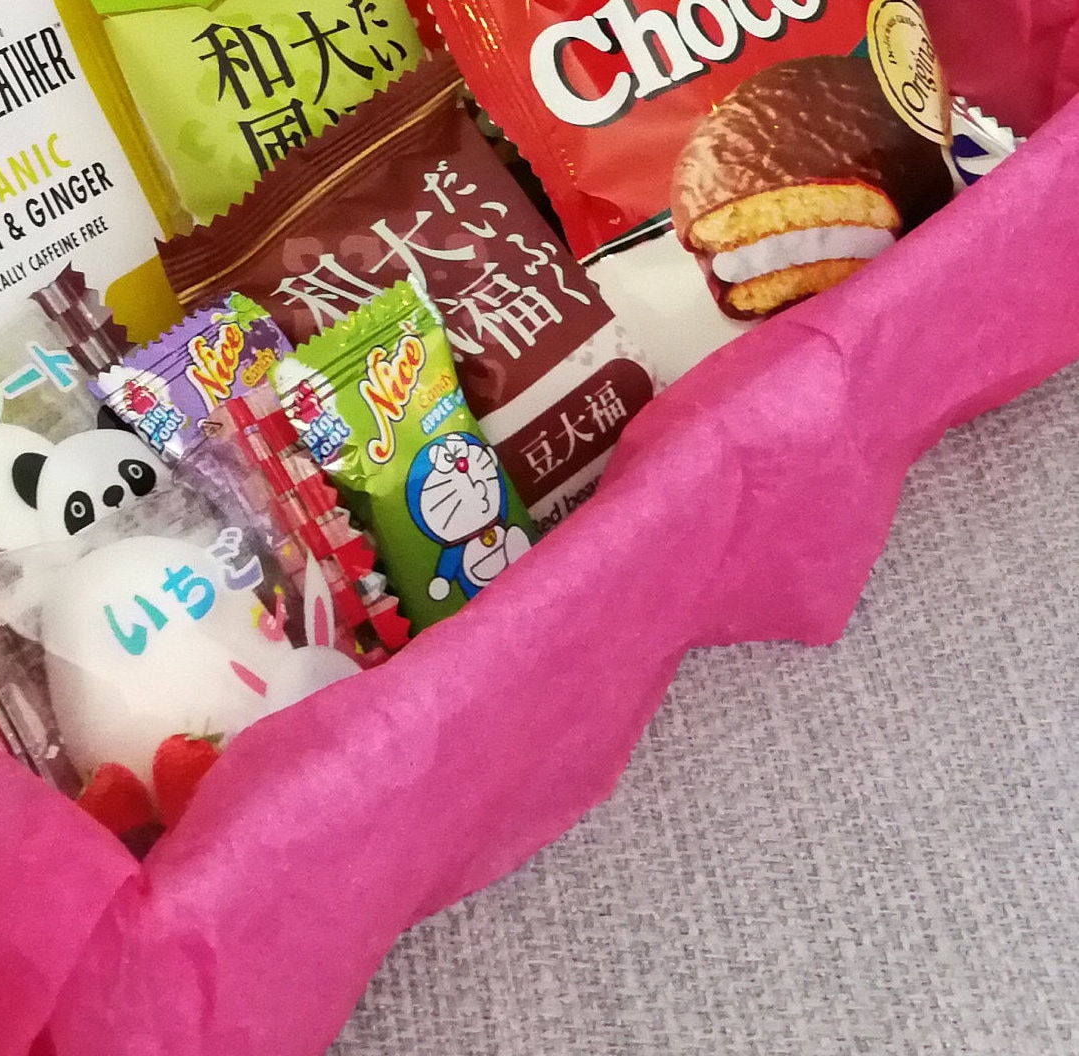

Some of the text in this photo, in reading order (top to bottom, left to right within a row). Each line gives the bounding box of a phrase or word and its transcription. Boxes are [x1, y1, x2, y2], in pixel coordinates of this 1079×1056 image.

[4, 212, 28, 241] &
[25, 160, 114, 228] GINGER
[28, 234, 81, 272] CAFFEINE
[81, 215, 109, 244] FREE
[185, 322, 244, 413] Nice
[359, 335, 426, 464] Nice
[520, 381, 628, 484] 豆大福
[104, 528, 264, 655] いちご
